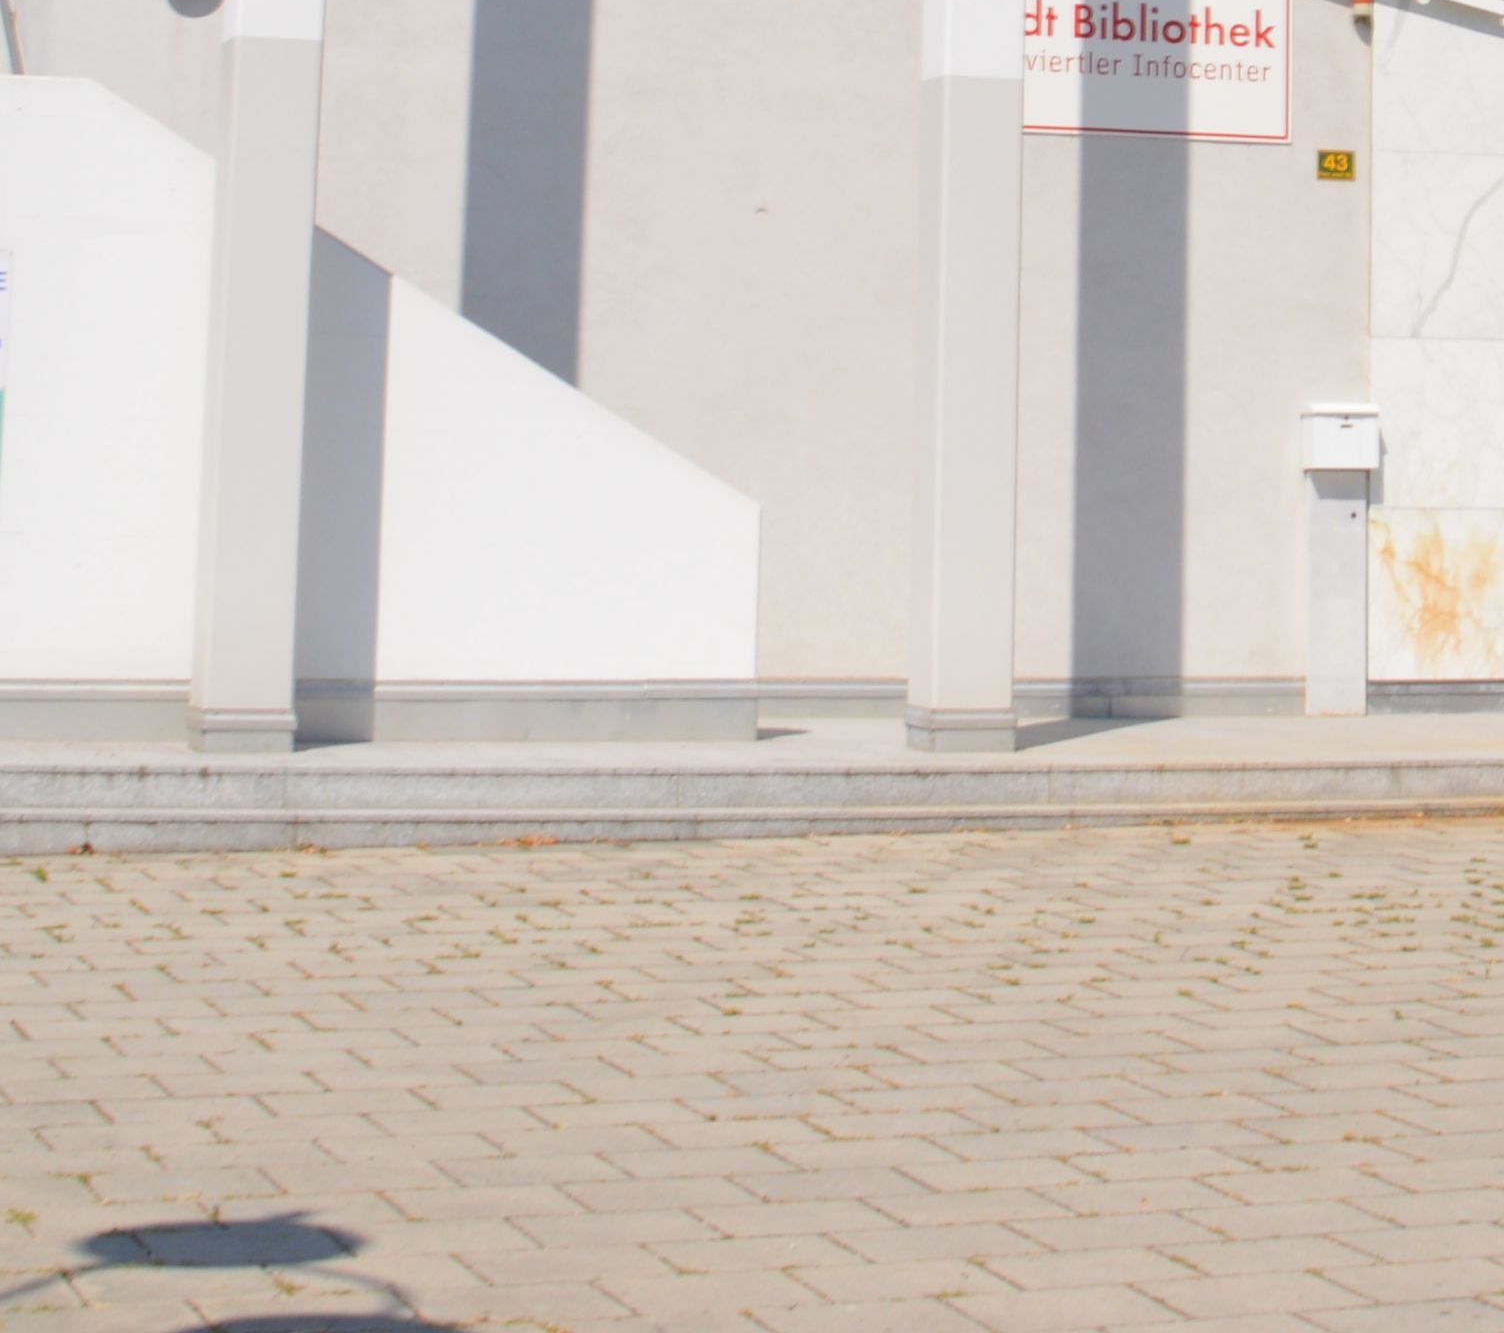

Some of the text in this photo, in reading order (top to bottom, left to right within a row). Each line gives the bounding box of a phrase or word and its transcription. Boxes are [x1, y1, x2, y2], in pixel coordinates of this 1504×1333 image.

[1073, 1, 1276, 49] Bibliothek
[1132, 52, 1272, 83] Infocenter
[1322, 153, 1349, 172] 43
